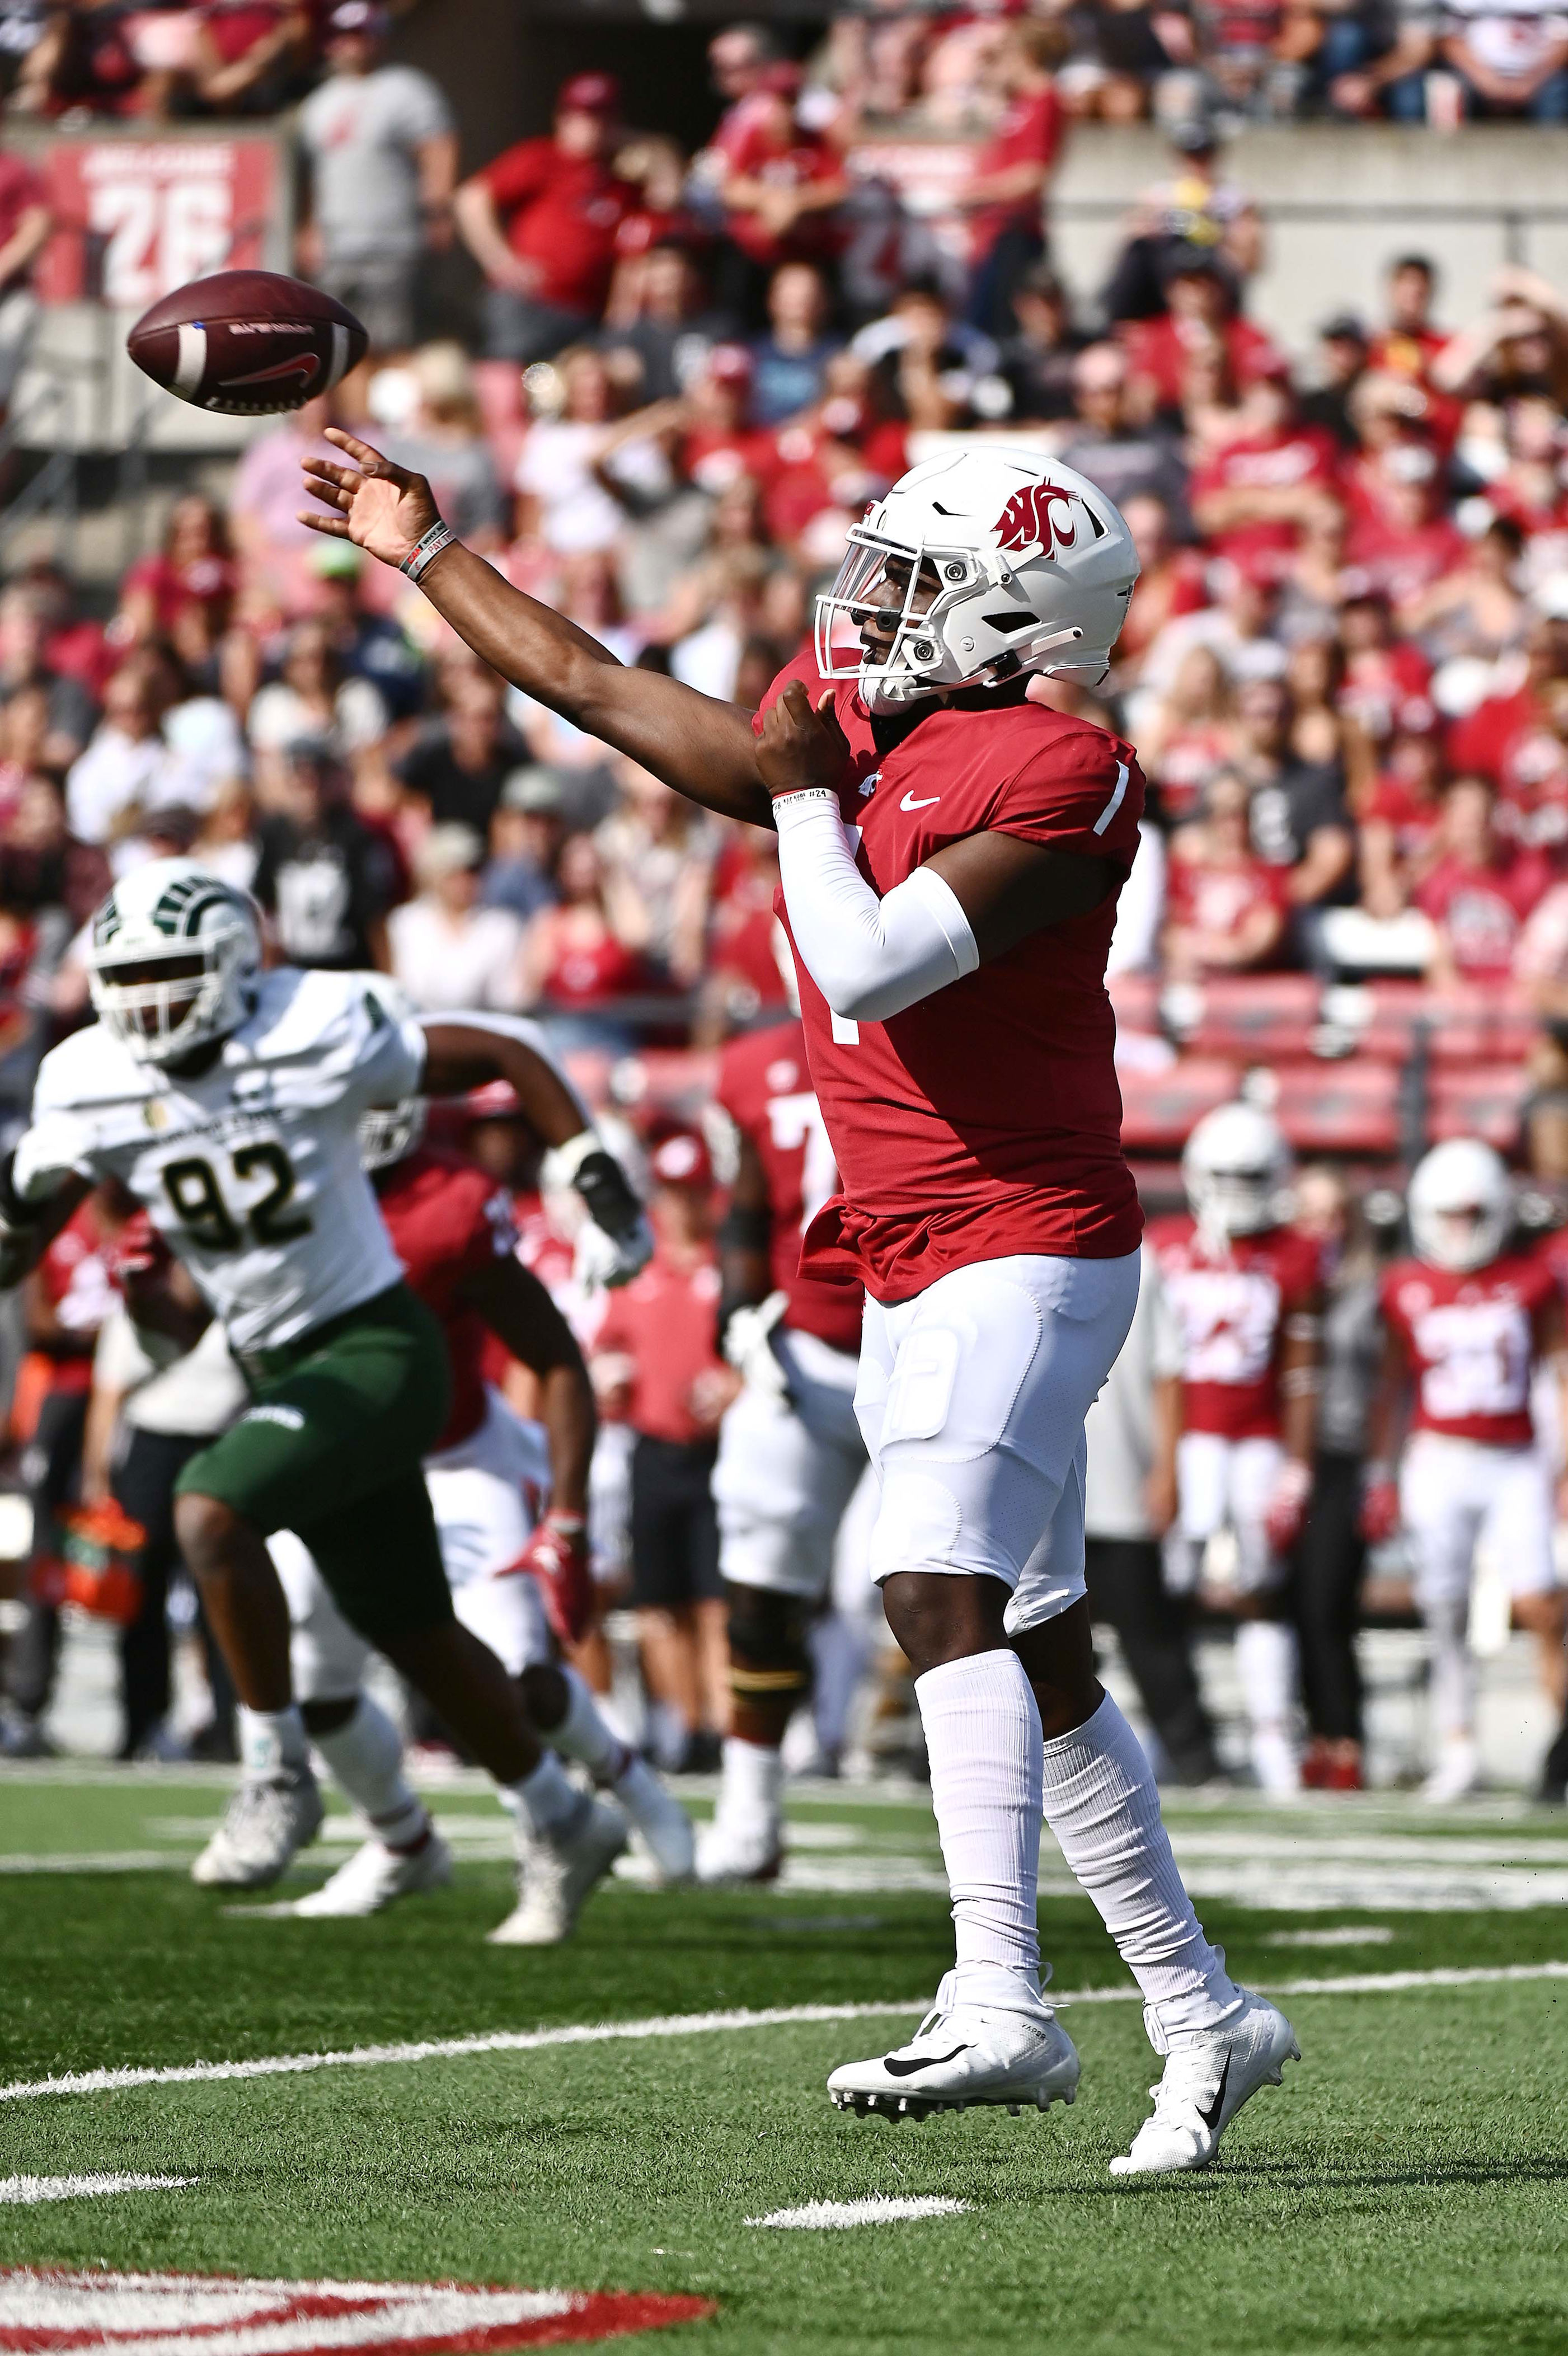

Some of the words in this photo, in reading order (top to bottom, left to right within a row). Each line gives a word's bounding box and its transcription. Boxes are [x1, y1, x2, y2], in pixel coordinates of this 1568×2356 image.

[428, 539, 443, 554] PAY
[1092, 760, 1129, 836] 1
[162, 1141, 312, 1252] 92
